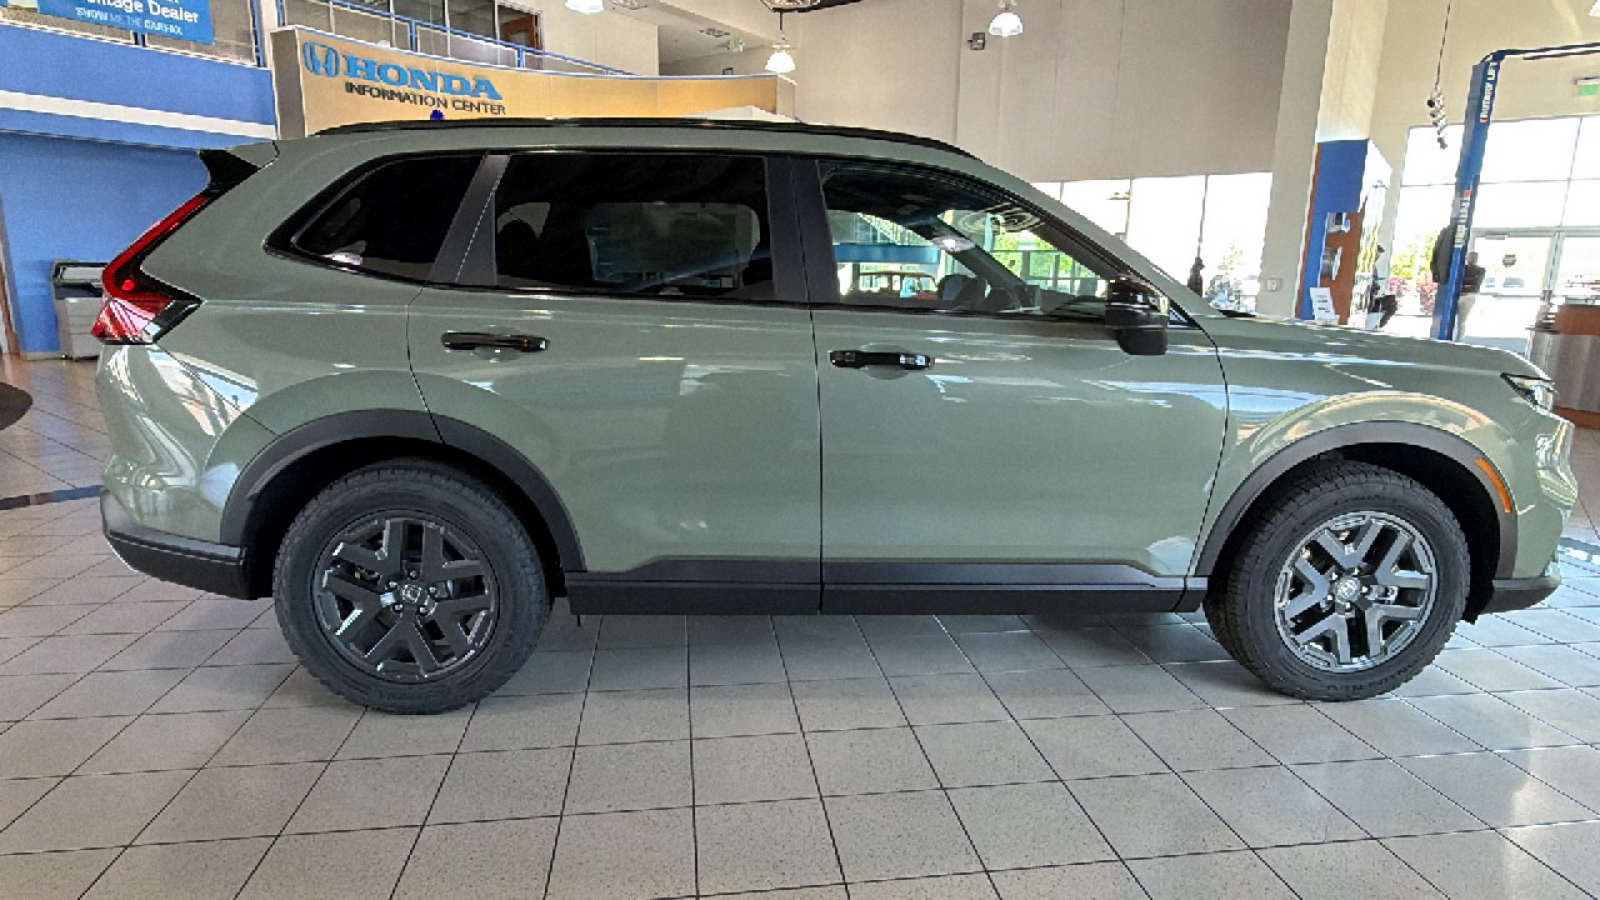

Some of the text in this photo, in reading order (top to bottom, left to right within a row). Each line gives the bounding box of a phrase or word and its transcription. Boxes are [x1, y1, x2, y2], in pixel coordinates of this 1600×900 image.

[147, 0, 199, 23] Dealer
[342, 54, 503, 100] HONDA
[345, 81, 506, 116] INFORMATION CENTER
